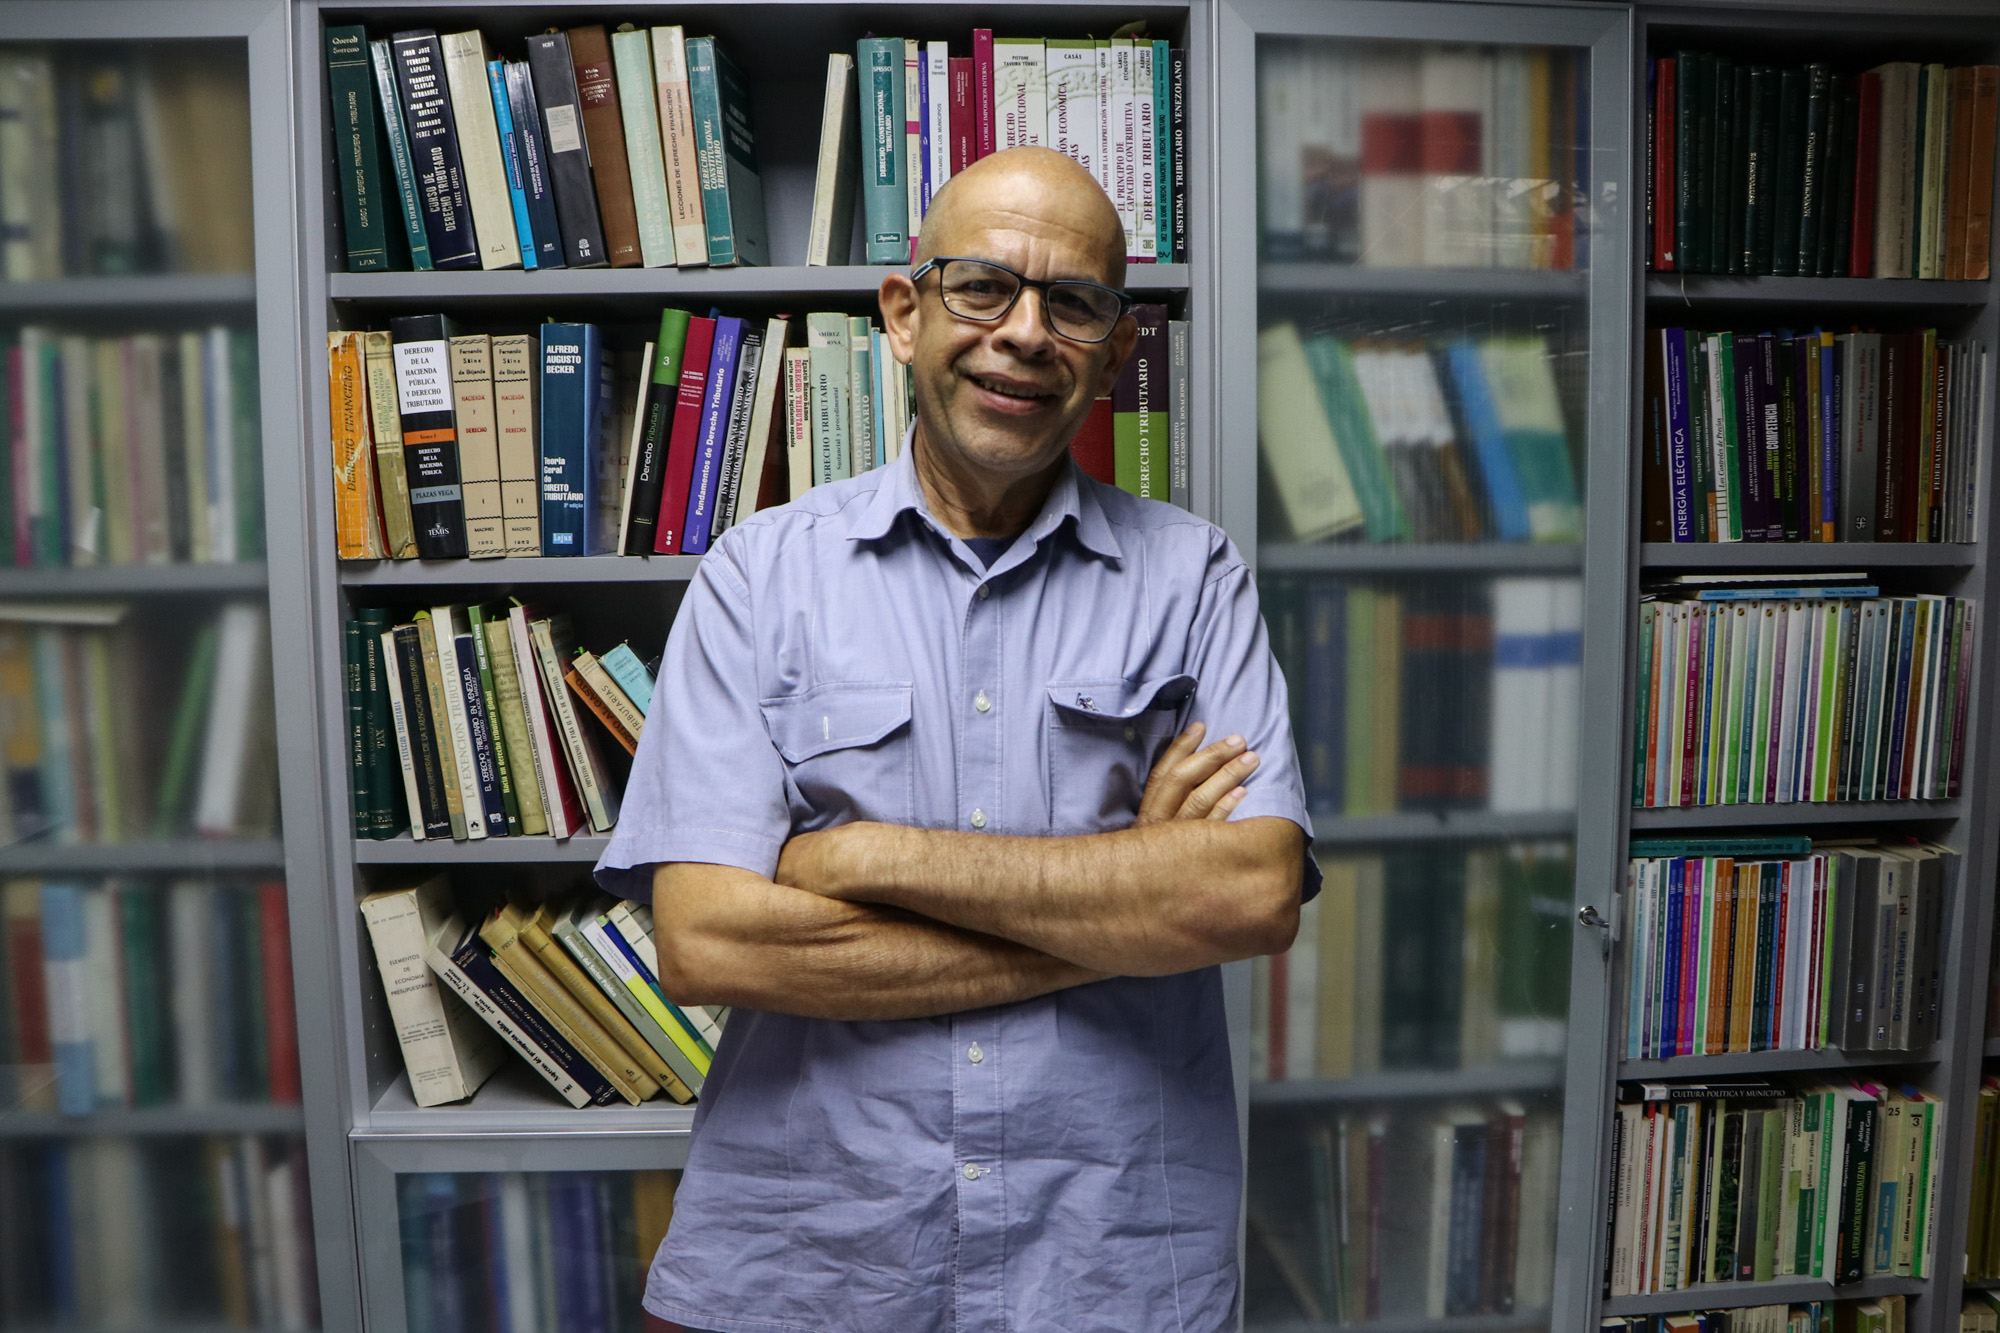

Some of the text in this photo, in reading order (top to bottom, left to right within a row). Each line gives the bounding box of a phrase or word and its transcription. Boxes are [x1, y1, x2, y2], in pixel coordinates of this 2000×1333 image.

[350, 90, 359, 124] TRIBUTARIO
[666, 87, 676, 131] FINANCIERO
[1058, 82, 1067, 133] ECONÓMICA
[353, 132, 363, 167] FINANCIERO
[671, 132, 680, 167] DERECHO
[705, 118, 717, 189] CONSTITUCIONAL
[876, 90, 886, 178] DERECHO CONSTITUCIONAL
[700, 149, 710, 190] DERECHO
[713, 138, 725, 189] TRIBUTARIO
[1117, 141, 1125, 211] EL PRINCIPIO DE
[1125, 101, 1135, 211] CAPACIDAD CONTRIBUTIVA
[1142, 102, 1153, 220] DERECHO TRIBUTARIO
[357, 168, 365, 194] DERECHO
[359, 196, 366, 205] DE
[423, 172, 438, 213] CURSO DE
[433, 145, 455, 232] DERECHO TRIBUTARIO
[676, 179, 686, 219] LECCIONES
[360, 208, 368, 227] CURSO
[1177, 237, 1184, 249] EL
[404, 346, 434, 355] DERECHO
[420, 357, 430, 365] LA
[547, 345, 579, 353] ALFREDO
[547, 355, 581, 363] AUGUSTO
[547, 365, 575, 373] BECKER
[663, 357, 670, 365] 3
[405, 367, 437, 376] HACIENDA
[408, 377, 436, 386] PÚBLICA
[712, 367, 725, 409] Tributario
[406, 398, 443, 408] TRIBUTARIO
[411, 388, 442, 397] DERECHO
[344, 364, 357, 491] DERECHO FINANCIERO
[647, 402, 660, 442] Tributario
[707, 410, 719, 445] Derecho
[726, 367, 756, 517] DEL DERECHO TRIBUTARIO MEXICANO
[820, 373, 831, 483] DERECHO TRIBUTARIO
[863, 395, 871, 468] TRIBUTARIO
[1139, 358, 1149, 498] DERECHO TRIBUTARIO
[1764, 403, 1778, 450] COMPETENCIA
[1934, 365, 1944, 490] FEDERALISMO COOPERATIVO
[419, 461, 444, 469] HACIENDA
[544, 457, 565, 465] Teoria
[544, 466, 563, 474] Geral
[641, 442, 654, 482] Derecho
[705, 446, 713, 458] de
[416, 489, 454, 499] PLAZAS VEGA
[544, 484, 569, 492] DIREITO
[544, 492, 584, 500] TRIBUTÁRIO
[696, 459, 711, 515] Fundamentos
[1675, 427, 1687, 536] ENERGÍA ELÉCTRICA
[553, 534, 572, 543] Lejus
[442, 648, 462, 719] TRIBUTARIA
[575, 677, 614, 721] AL GASTO
[600, 683, 643, 731] TRIBUTARIAS
[463, 666, 493, 792] EL DERECHO TRIBUTARIO EN VENEZUELA
[486, 689, 510, 794] Hacia un derecho tributario global
[454, 721, 472, 780] EXENCION
[464, 783, 475, 799] LA
[389, 953, 420, 966] ELEMENTOS
[564, 935, 586, 959] Economía
[581, 956, 593, 968] del
[588, 964, 604, 981] Sector
[600, 978, 618, 998] Público
[1893, 931, 1907, 1021] Doctrina Tributaria
[390, 981, 433, 997] PRESUPUESTARIA
[494, 1019, 560, 1081] Aspectos del presupuesto público
[1888, 1108, 1900, 1116] 25
[1913, 1118, 1920, 1127] 3
[1850, 1160, 1867, 1257] LA FEDERACIÓN DESCENTRALIZADA
